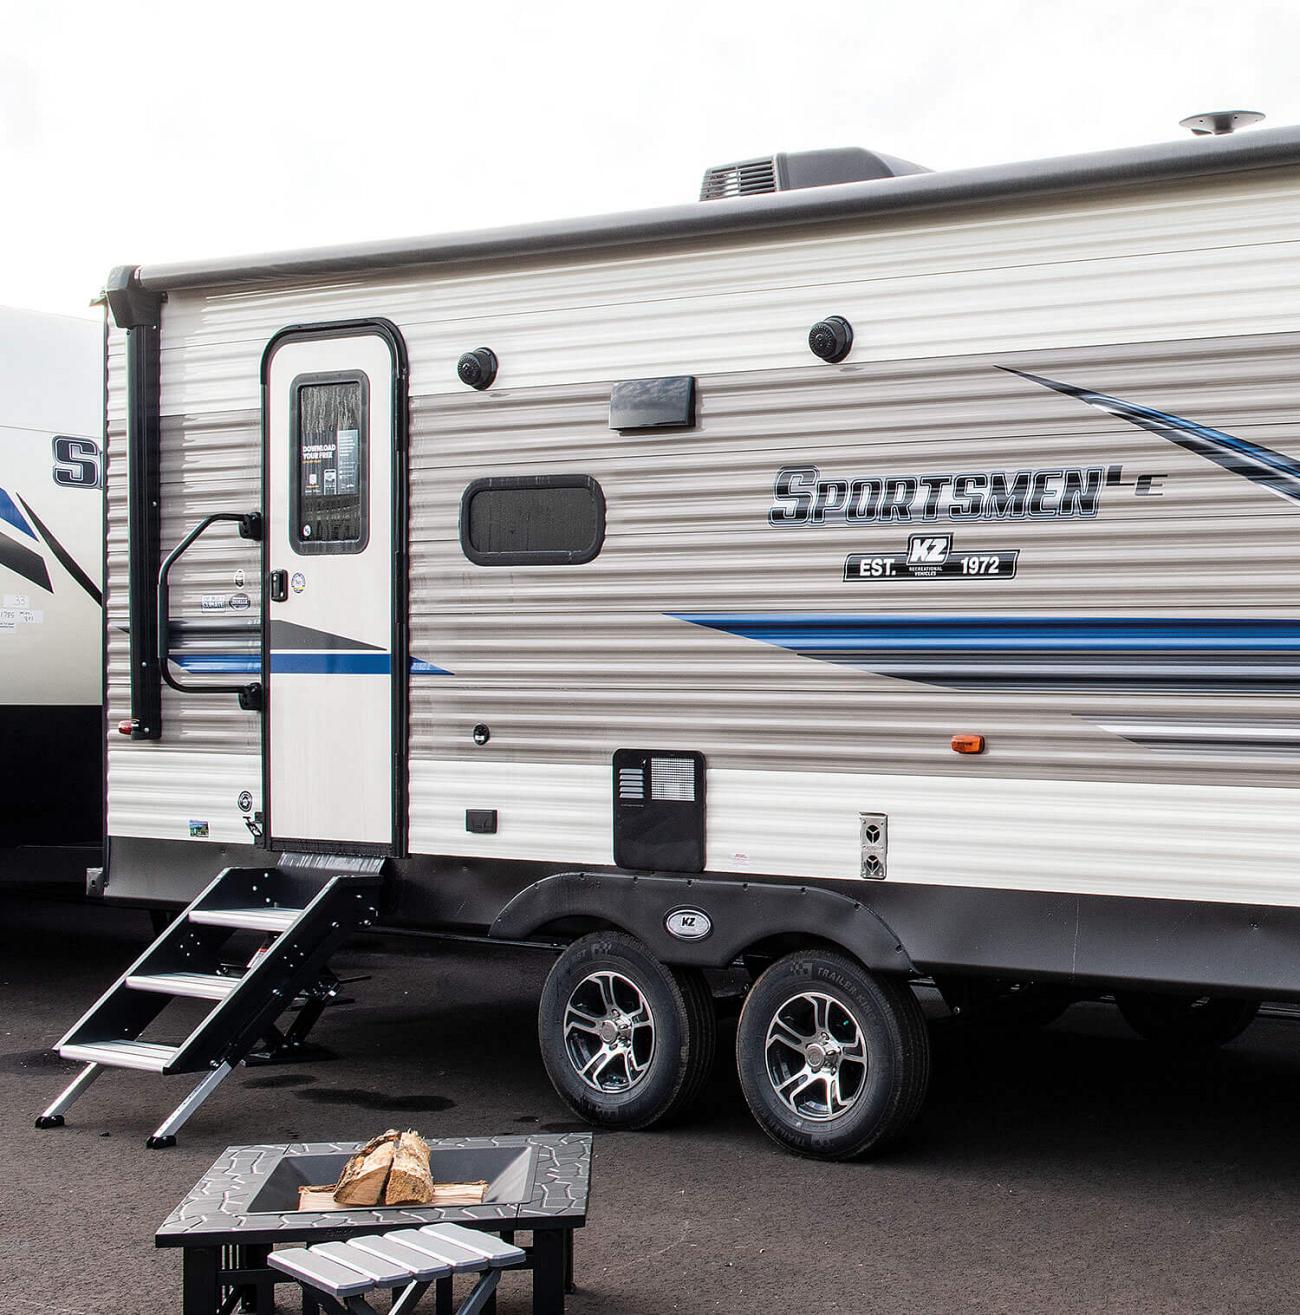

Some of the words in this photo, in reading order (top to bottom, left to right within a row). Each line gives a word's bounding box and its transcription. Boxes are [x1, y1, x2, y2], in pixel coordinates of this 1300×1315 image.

[303, 444, 336, 453] DOWNLOAD
[52, 435, 103, 490] S
[768, 464, 1106, 528] SPORTSMEN
[910, 538, 948, 562] KZ
[859, 558, 896, 577] EST.
[960, 556, 1000, 575] 1972
[681, 916, 696, 927] KZ
